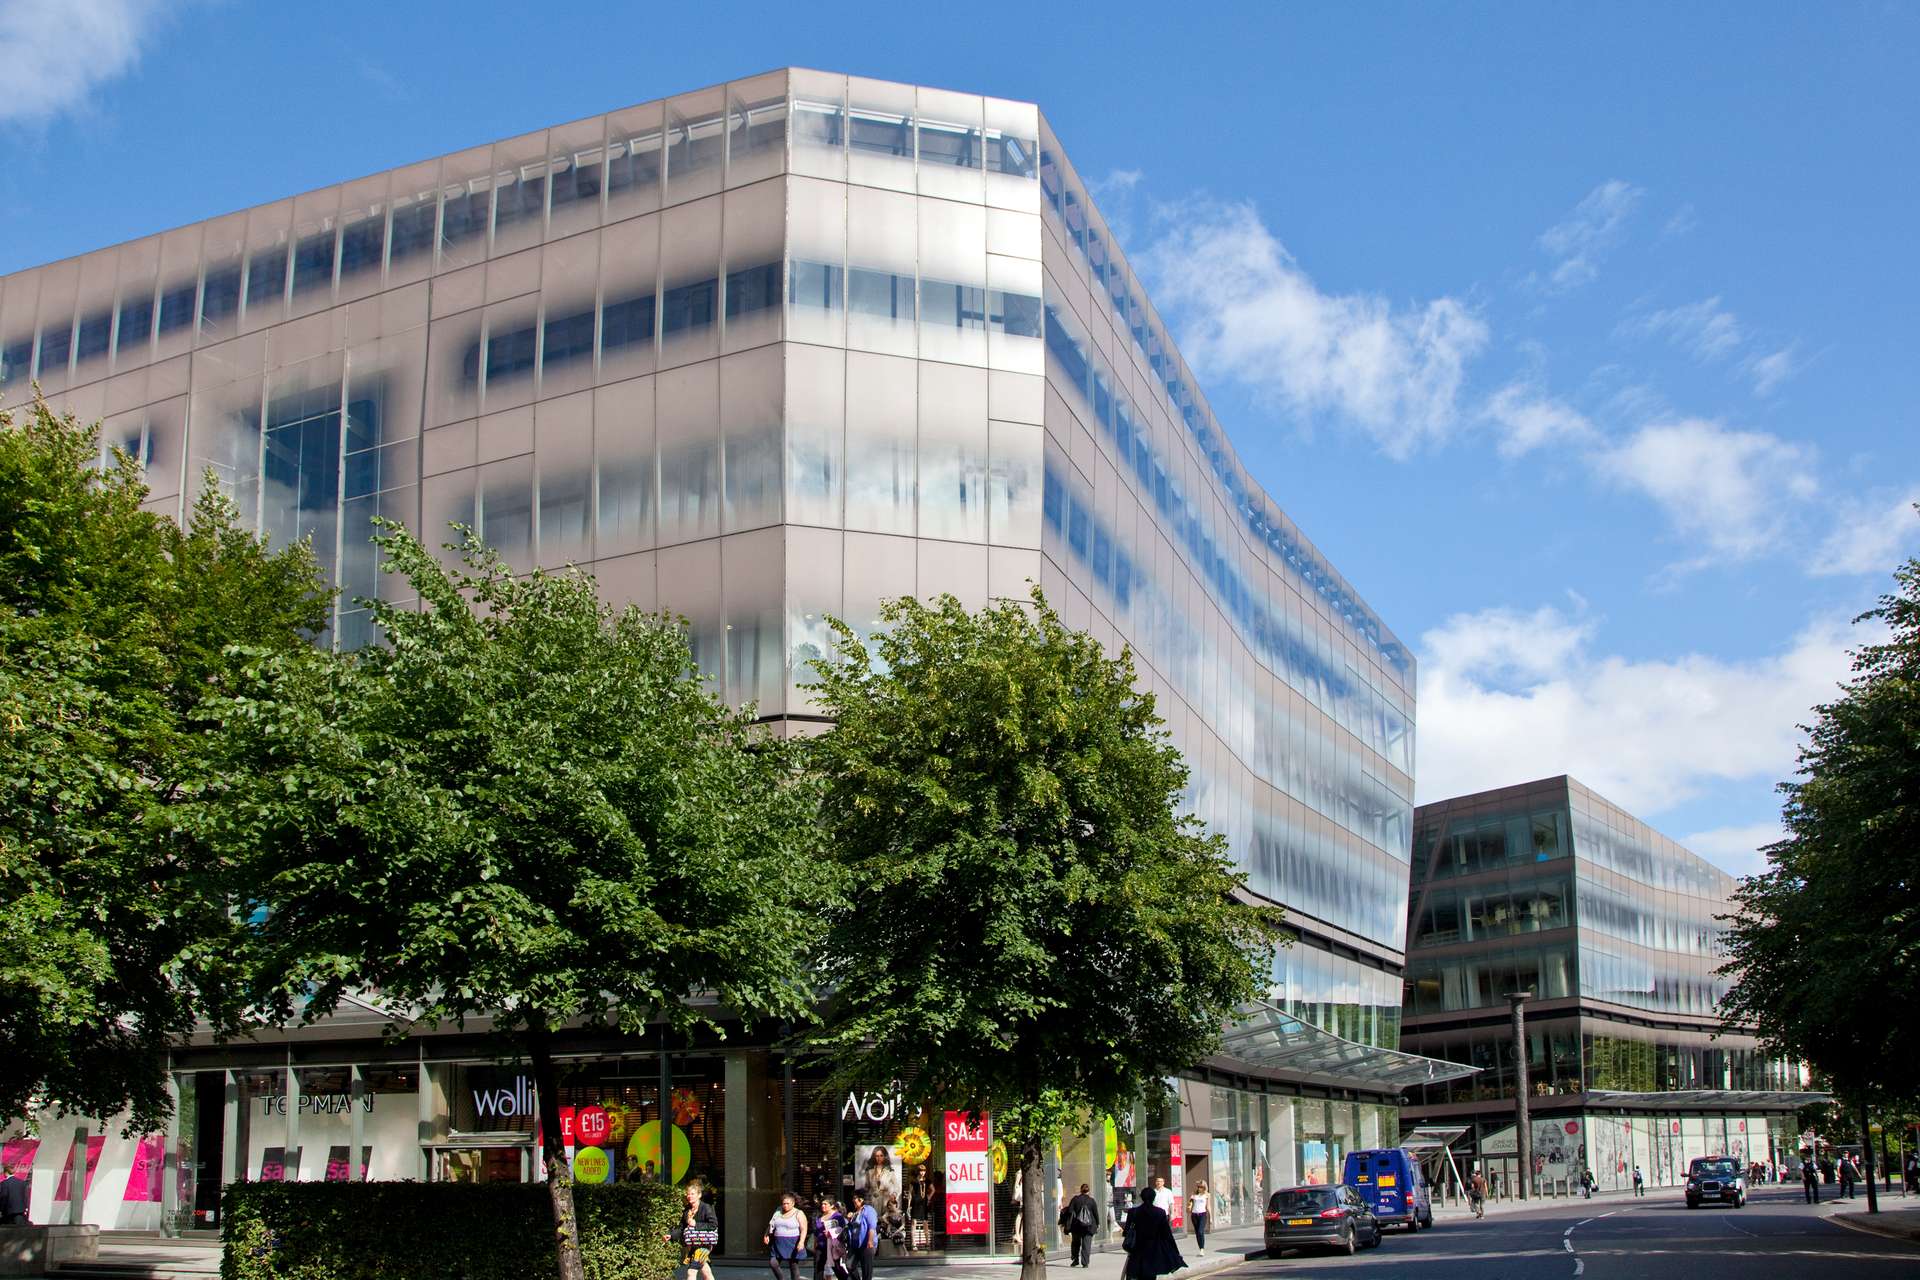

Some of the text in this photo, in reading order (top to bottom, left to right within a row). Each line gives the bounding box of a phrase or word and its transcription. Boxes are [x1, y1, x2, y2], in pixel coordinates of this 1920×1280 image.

[473, 1075, 533, 1117] walli
[581, 1112, 605, 1133] £15
[950, 1163, 985, 1181] SALE
[950, 1203, 986, 1222] SALE
